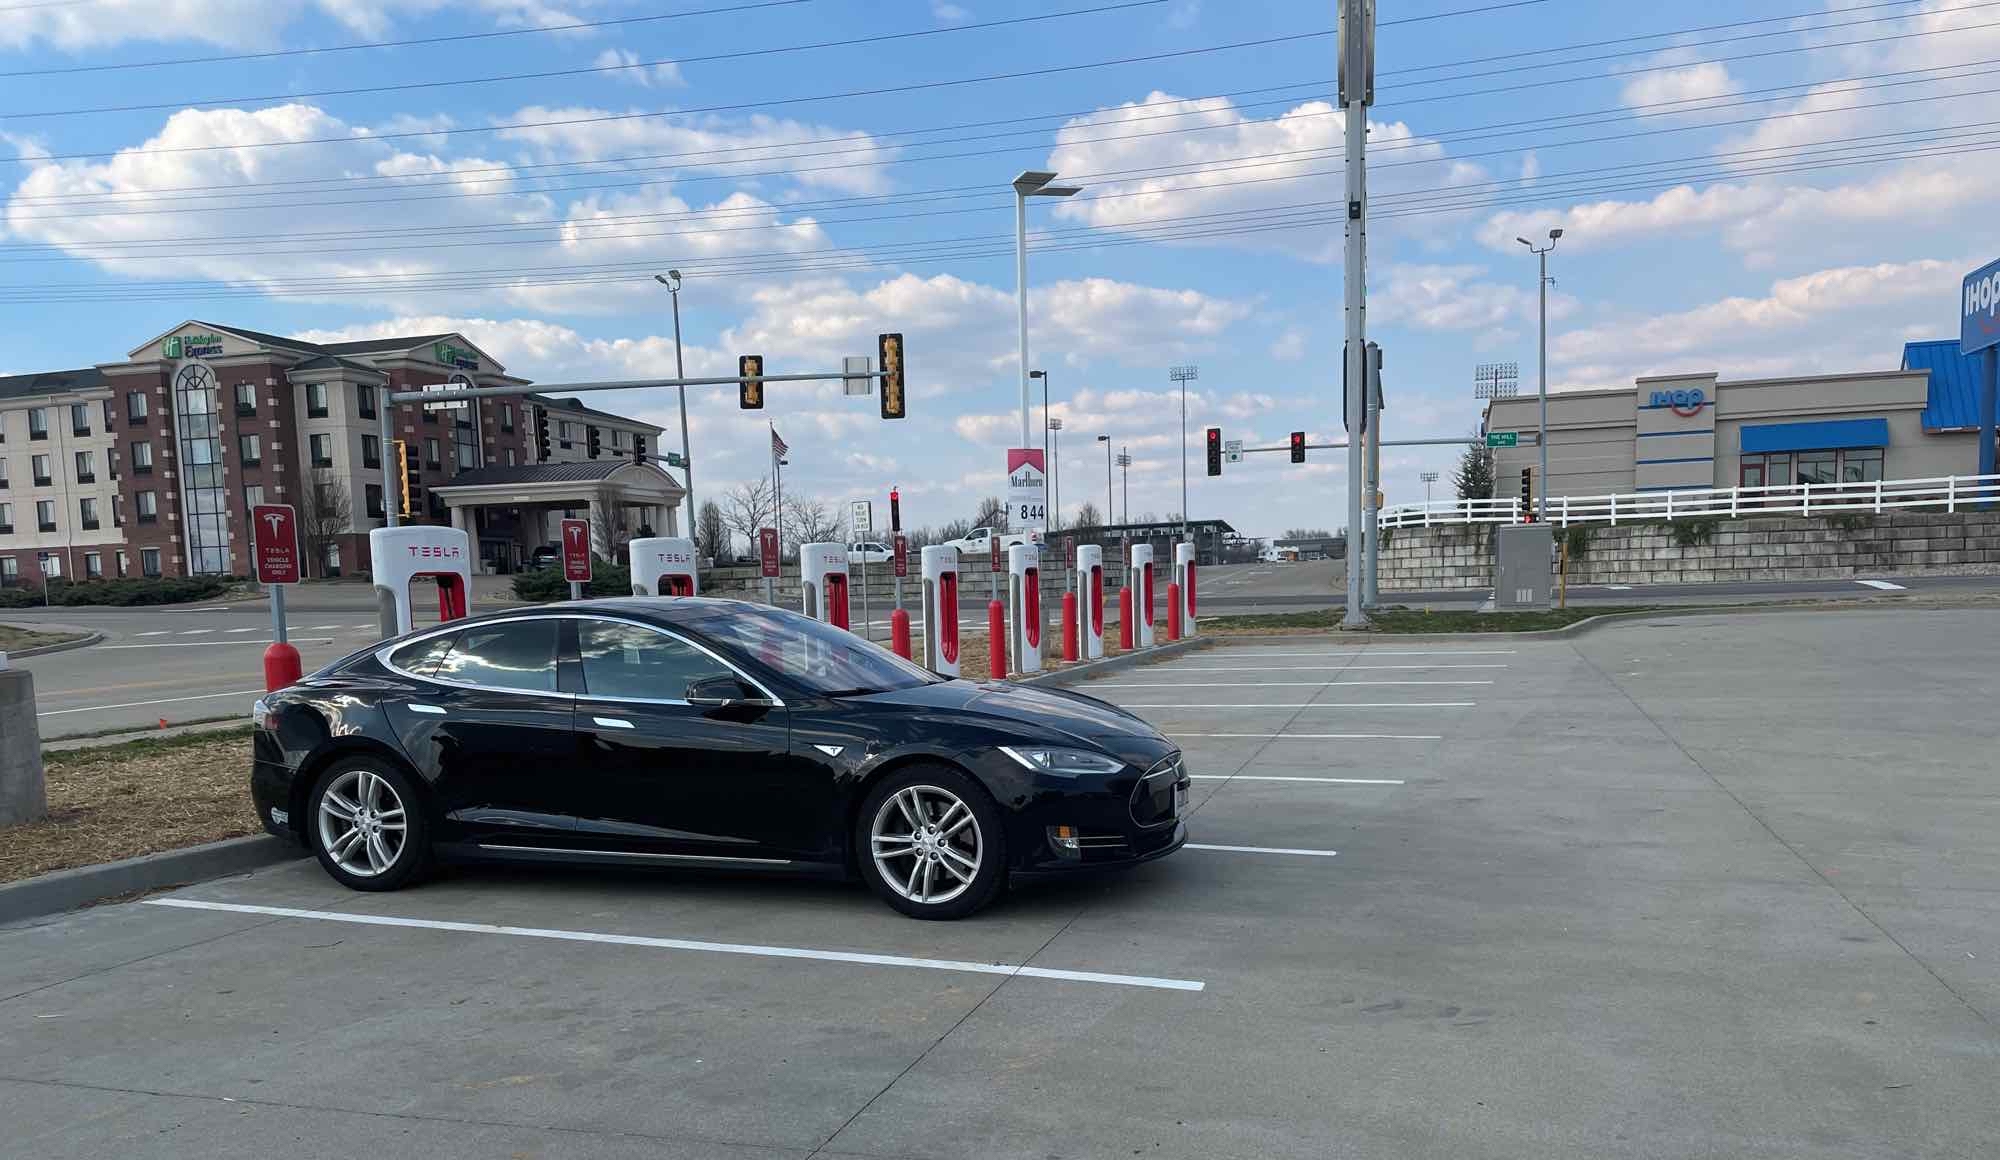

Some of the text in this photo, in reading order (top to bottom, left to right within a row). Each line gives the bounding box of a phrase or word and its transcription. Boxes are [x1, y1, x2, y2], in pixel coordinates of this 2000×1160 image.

[1965, 271, 2000, 317] IHOP
[1650, 389, 1704, 410] IHOP
[1011, 471, 1043, 488] Marlboro
[408, 546, 460, 558] TESLA
[657, 553, 691, 563] TESLA
